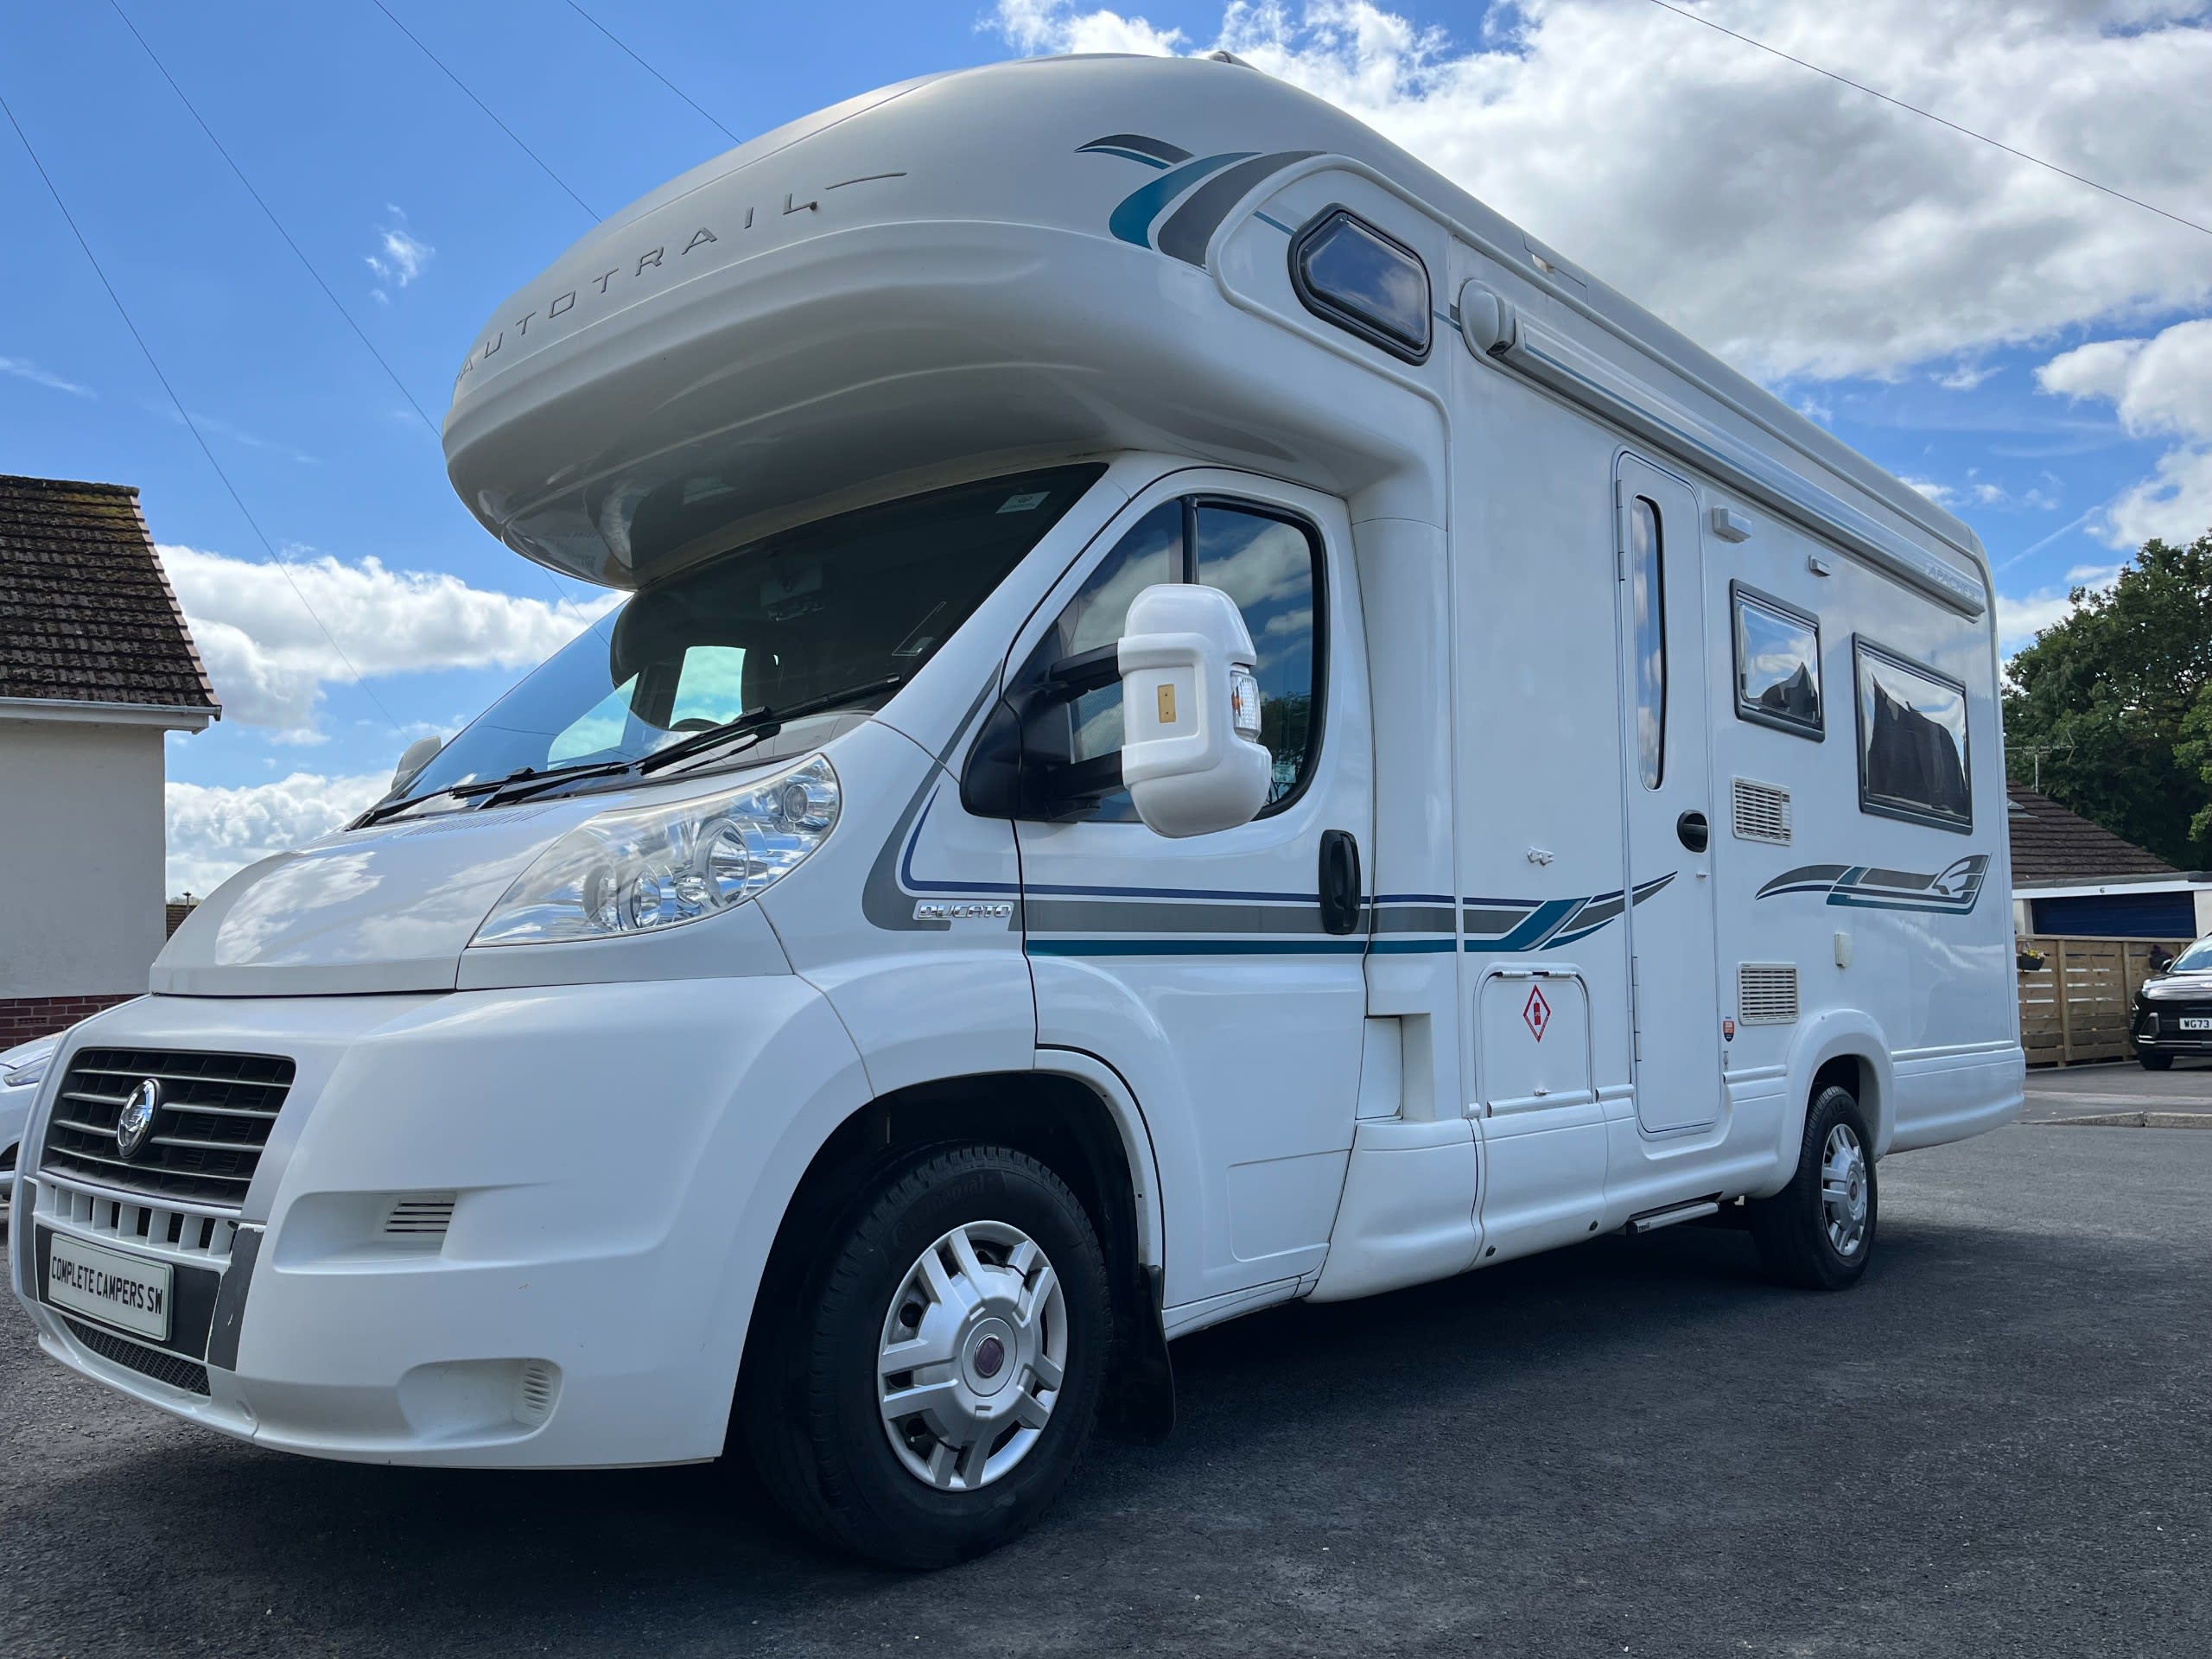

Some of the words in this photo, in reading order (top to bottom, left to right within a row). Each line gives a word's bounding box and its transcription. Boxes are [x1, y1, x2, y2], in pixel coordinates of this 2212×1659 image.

[456, 193, 817, 381] AUTOTRAIL
[918, 905, 1011, 918] DUCATO
[2183, 1020, 2209, 1028] WG73
[52, 1255, 94, 1294] COMPLETE
[96, 1272, 144, 1309] CAMPERS
[147, 1286, 163, 1314] SW
